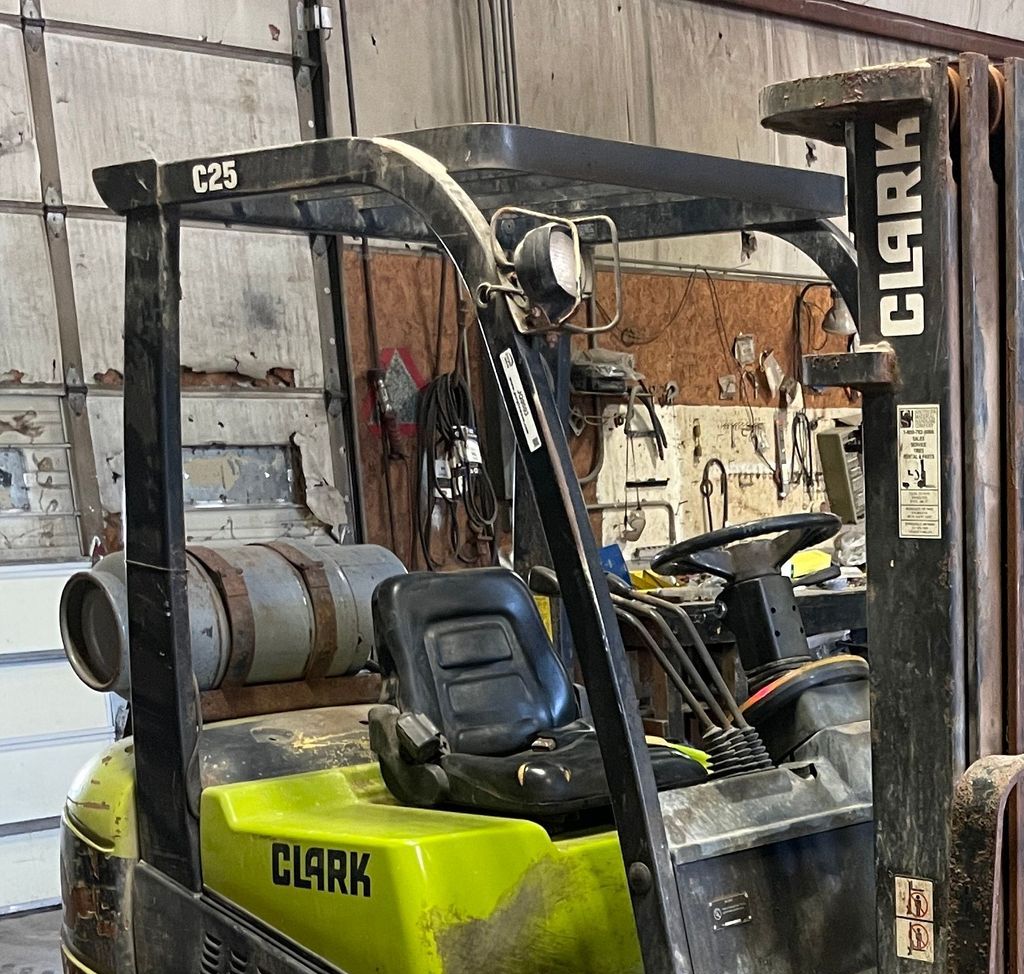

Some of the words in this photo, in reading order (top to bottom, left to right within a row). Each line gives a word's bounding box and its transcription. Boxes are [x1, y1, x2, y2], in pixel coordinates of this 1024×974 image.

[192, 160, 238, 193] C25
[875, 116, 924, 337] CLARK
[272, 842, 371, 898] CLARK
